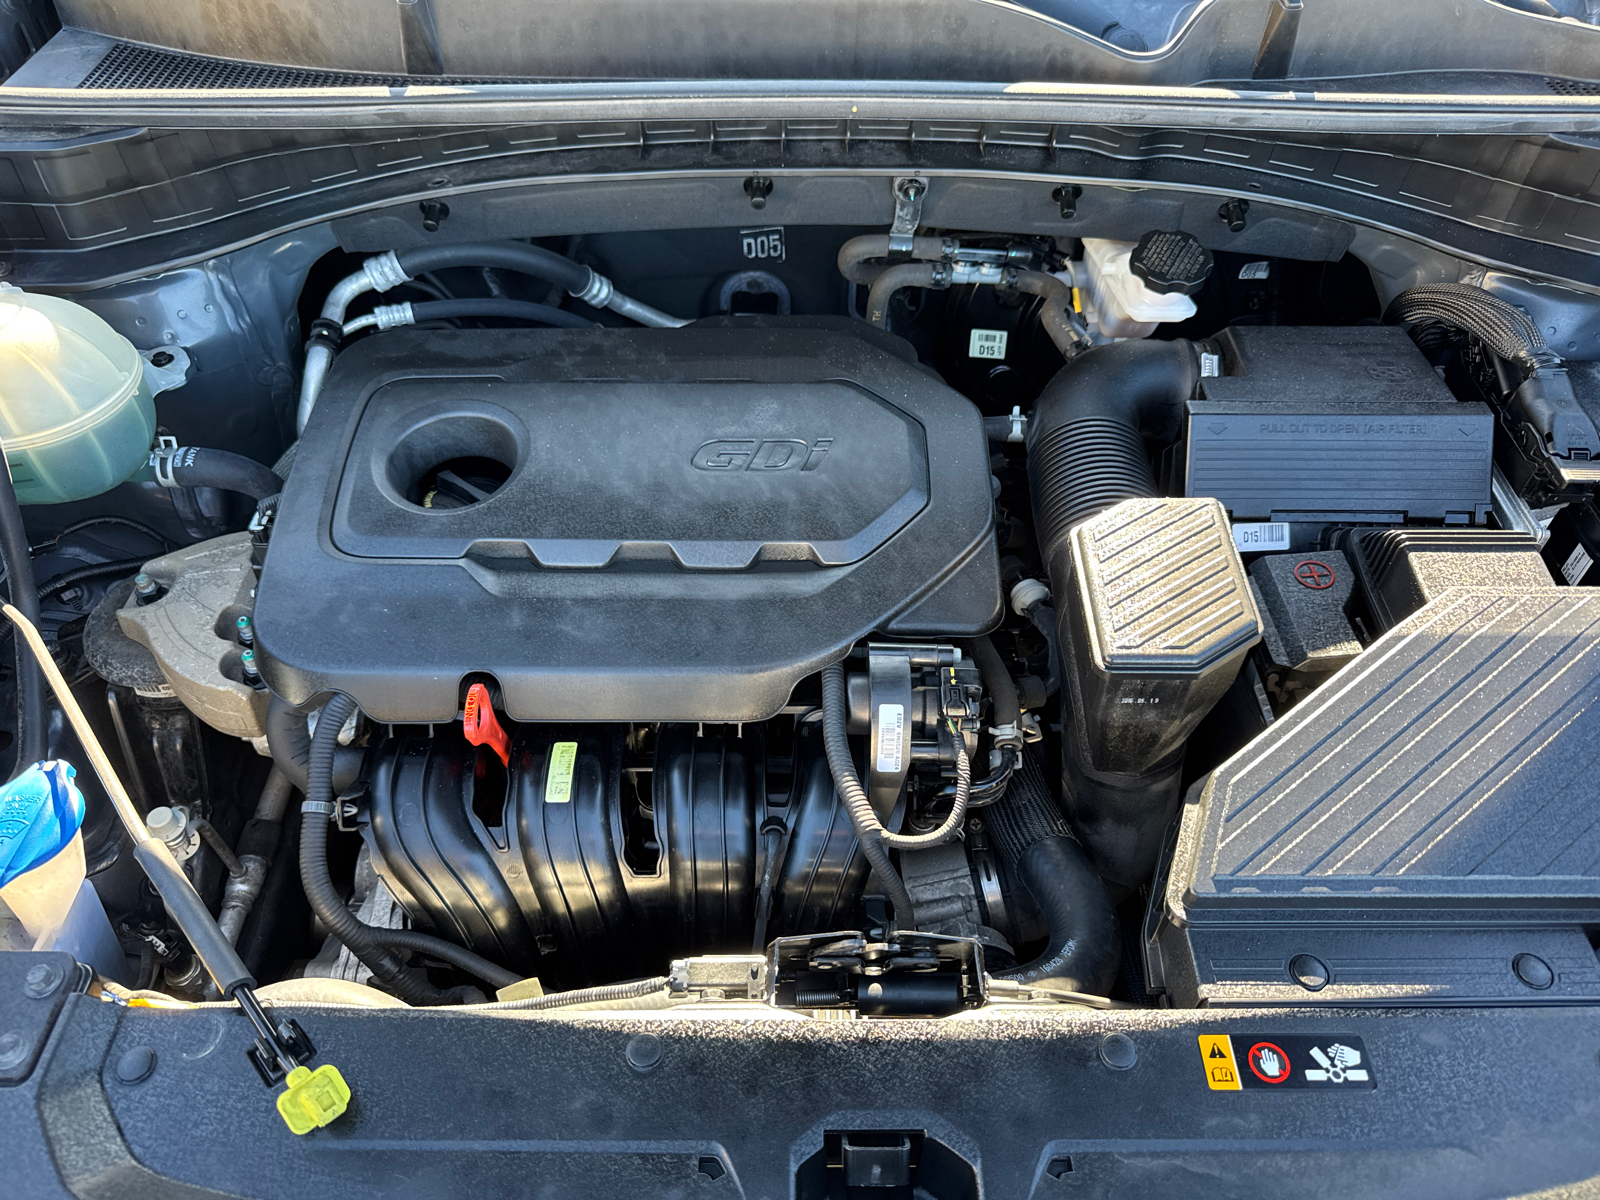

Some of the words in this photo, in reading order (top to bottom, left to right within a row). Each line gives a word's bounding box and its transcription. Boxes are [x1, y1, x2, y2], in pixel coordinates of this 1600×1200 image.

[742, 235, 782, 259] D05
[979, 345, 996, 357] D15
[1259, 423, 1287, 434] PULL
[1289, 423, 1310, 434] OUT
[1313, 423, 1327, 434] TO
[1330, 423, 1358, 434] OPEN
[184, 446, 201, 468] TANK
[1243, 531, 1259, 543] D15
